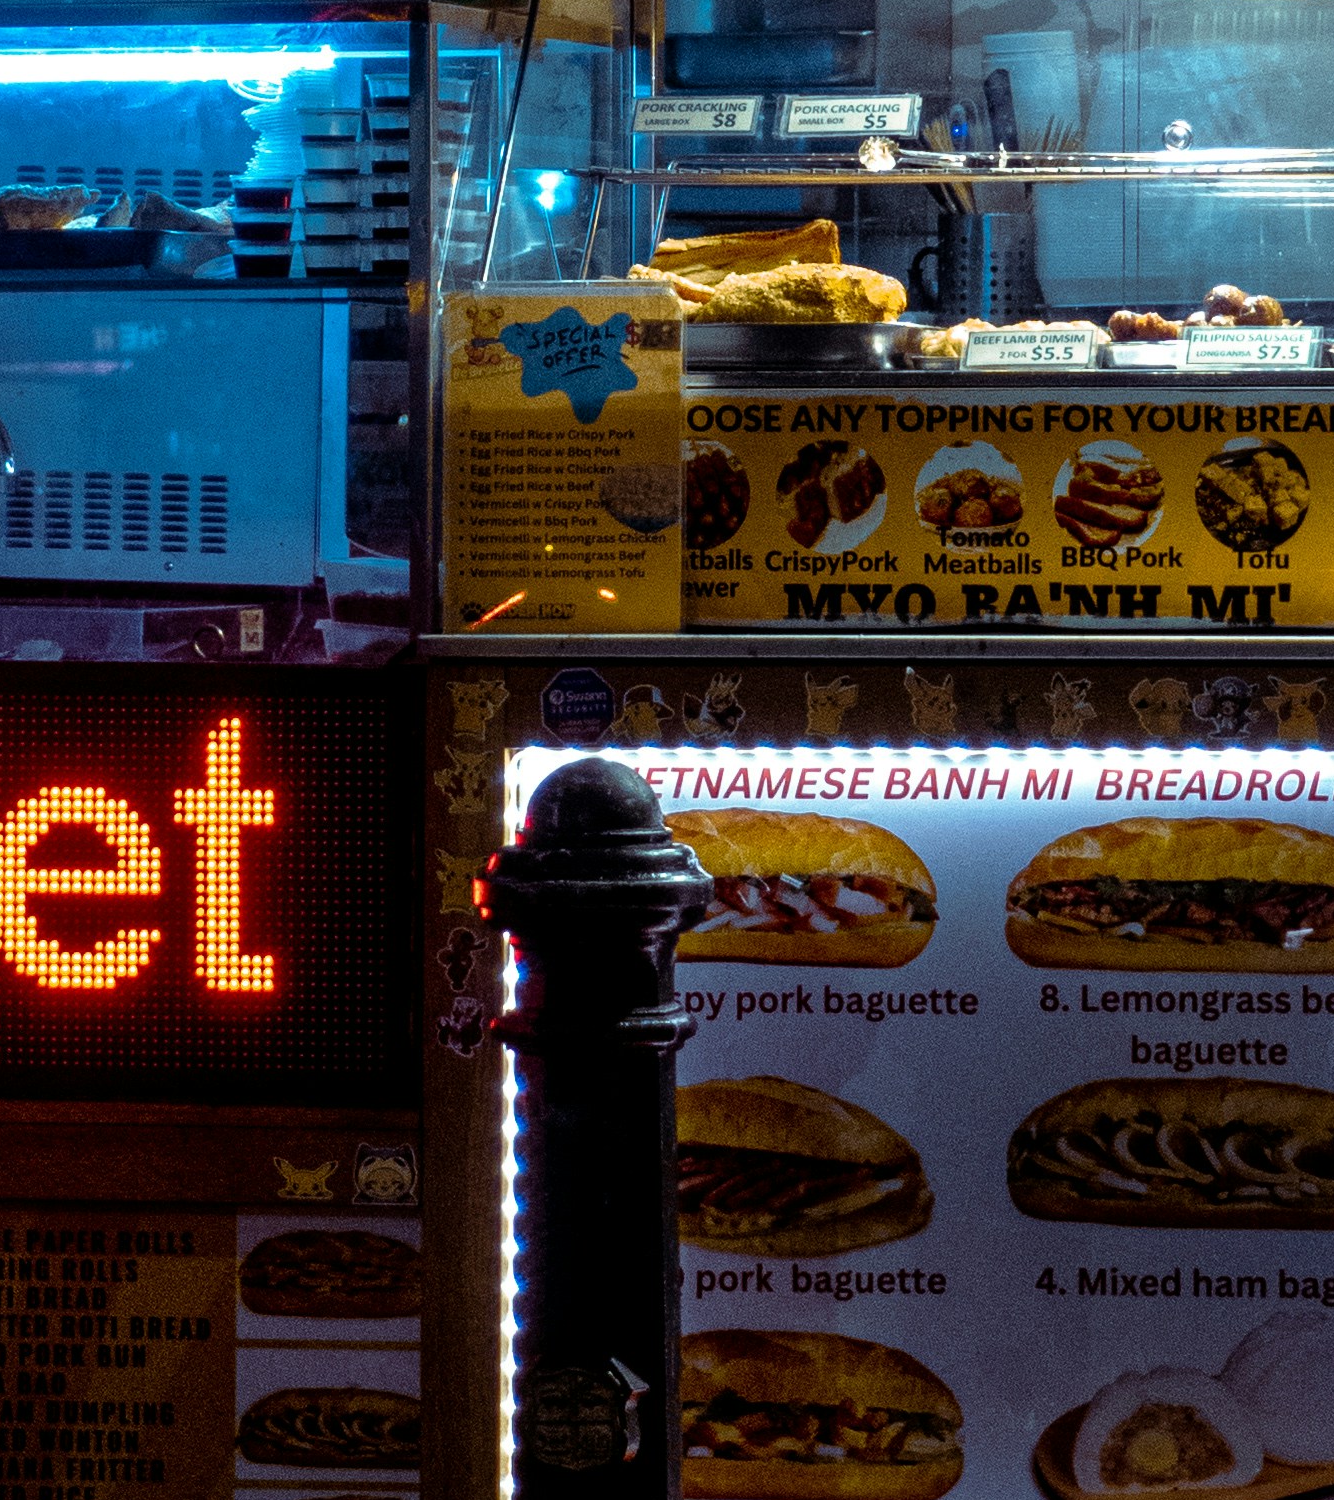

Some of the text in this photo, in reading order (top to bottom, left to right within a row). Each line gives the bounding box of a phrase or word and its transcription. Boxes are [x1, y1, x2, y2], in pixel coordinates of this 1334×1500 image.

[641, 101, 747, 113] PORK CRACKLING
[713, 113, 736, 128] $8
[863, 113, 887, 129] $5
[528, 323, 617, 350] SPECIAL
[973, 333, 1086, 345] BEEF LAMB DIMSIM
[1192, 332, 1305, 343] FILIPINO SAUSAGE
[543, 346, 607, 369] OFFER
[1031, 346, 1073, 361] $5.5
[1257, 344, 1300, 360] $7.5
[791, 405, 867, 432] ANY
[875, 405, 1034, 432] TOPPING
[1043, 405, 1113, 432] FOR
[1125, 405, 1225, 433] YOUR
[471, 430, 491, 442] Egg
[494, 429, 524, 440] Fried
[528, 429, 553, 440] Rice
[568, 429, 605, 442] Crispy
[609, 429, 635, 439] Pork
[936, 526, 1030, 547] Tomato
[765, 551, 898, 575] CrispyPork
[924, 553, 1042, 575] Meatballs
[1061, 546, 1183, 570] BBQ Pork
[1234, 548, 1289, 570] Tofu
[644, 767, 874, 800] ETNAMESE
[885, 768, 1009, 800] BANH
[1022, 769, 1074, 800] MI
[736, 986, 979, 1022] pork baguette
[1040, 985, 1068, 1013] 8.
[1082, 985, 1291, 1021] Lemongrass
[1131, 1036, 1287, 1071] baguette
[697, 1265, 947, 1300] pork baguette
[1036, 1269, 1066, 1295] 4.
[1078, 1269, 1181, 1296] Mixed
[1193, 1269, 1266, 1298] ham
